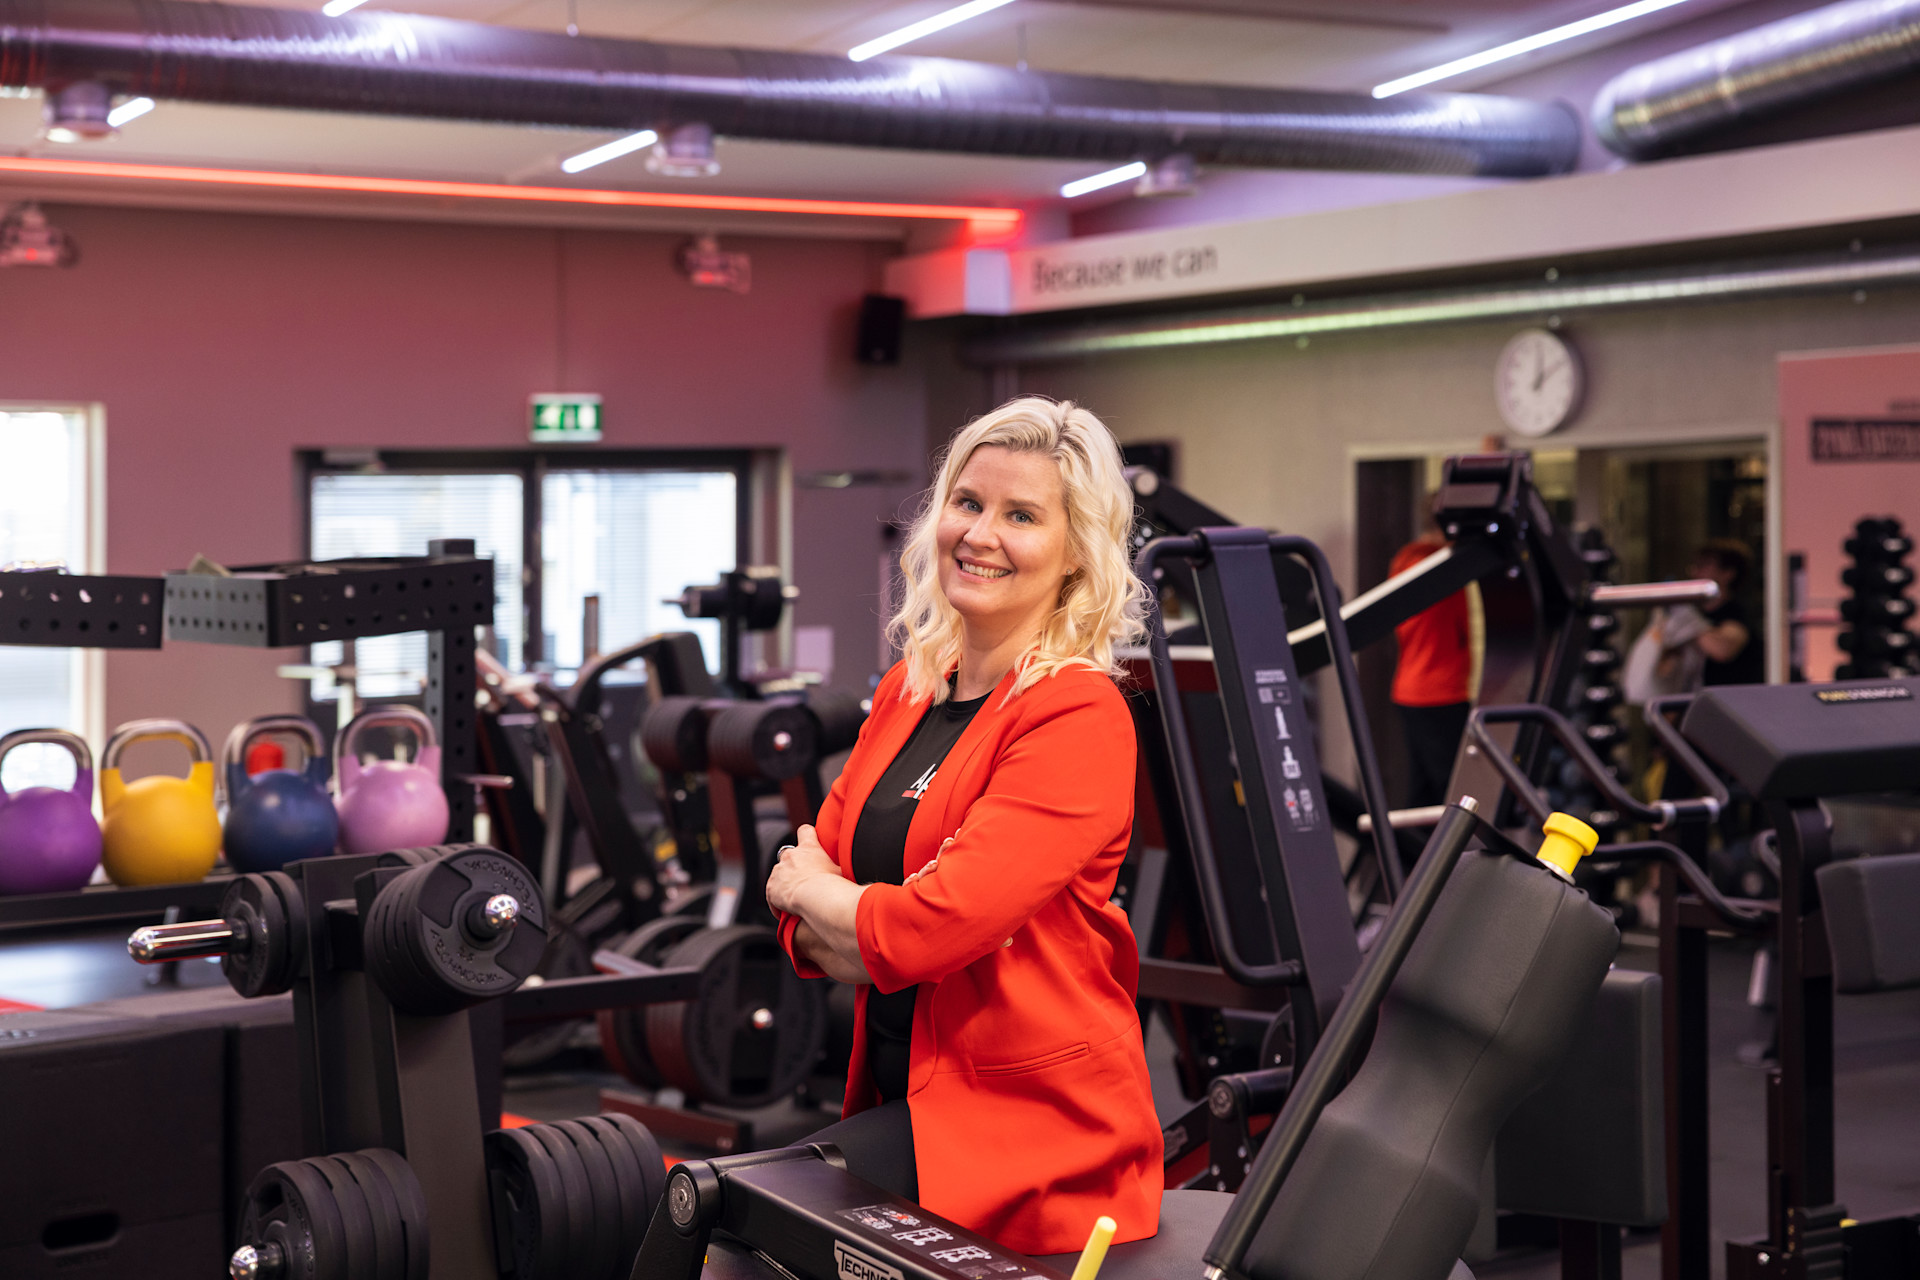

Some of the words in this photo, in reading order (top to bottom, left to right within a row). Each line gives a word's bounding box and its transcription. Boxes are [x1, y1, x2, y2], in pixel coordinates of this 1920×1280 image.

[1032, 257, 1126, 296] Because
[1132, 251, 1167, 282] we
[1171, 245, 1219, 278] can
